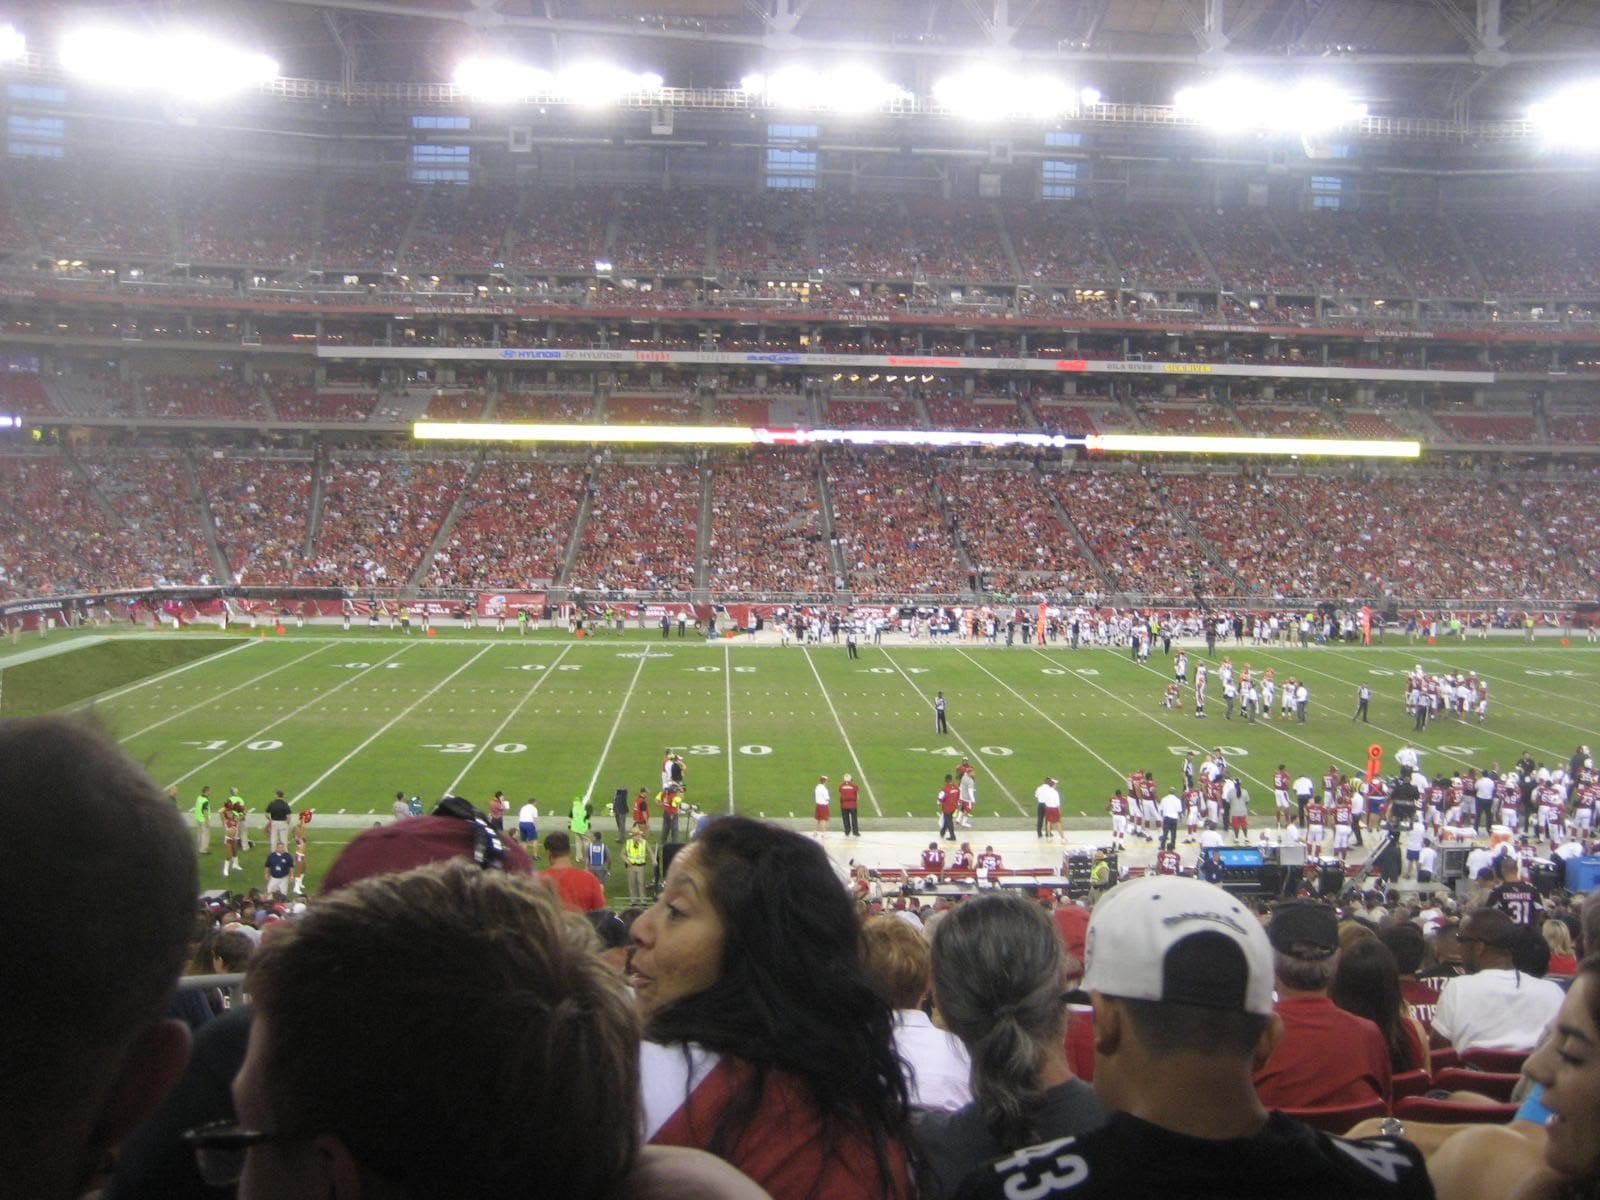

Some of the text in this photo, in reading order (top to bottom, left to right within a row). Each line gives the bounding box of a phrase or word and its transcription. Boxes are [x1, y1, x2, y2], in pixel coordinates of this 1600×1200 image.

[518, 350, 561, 358] HYUNDAI
[689, 744, 773, 755] 30
[928, 852, 940, 862] 71
[1507, 901, 1530, 924] 31
